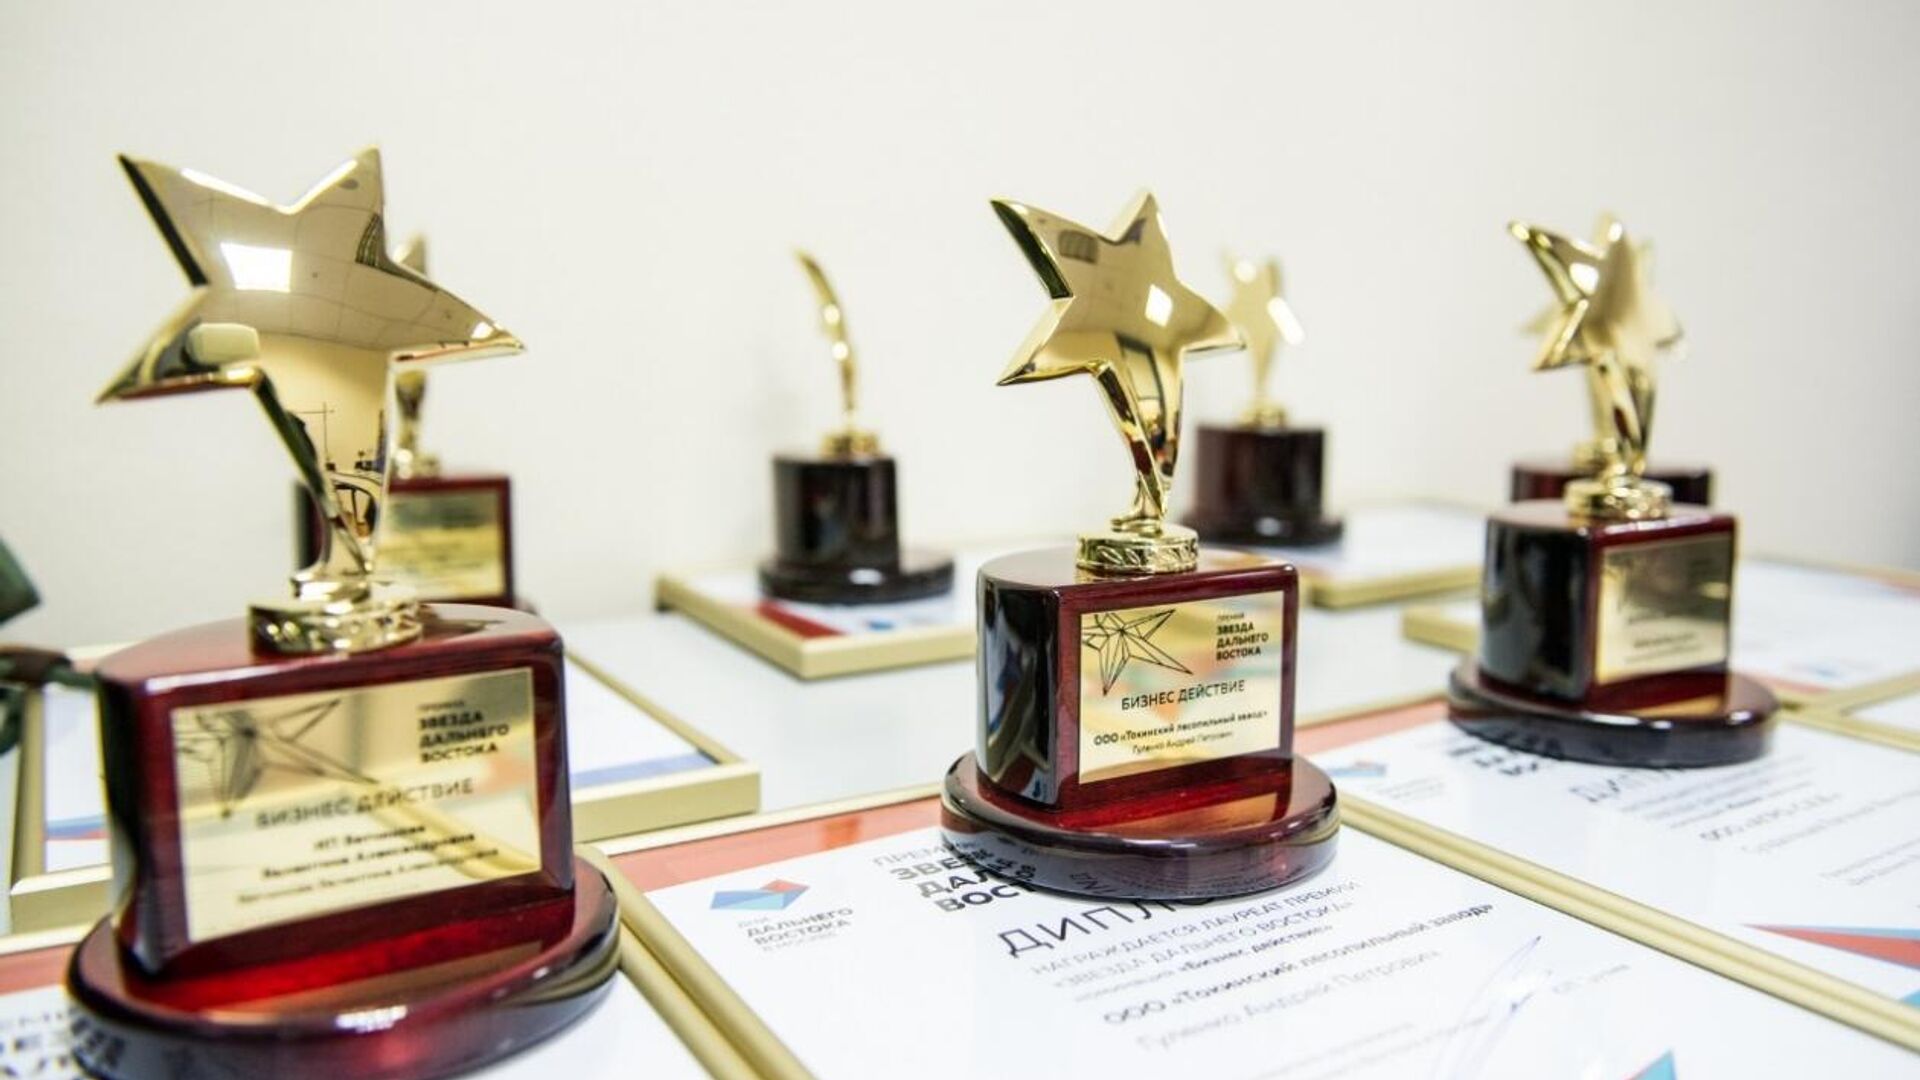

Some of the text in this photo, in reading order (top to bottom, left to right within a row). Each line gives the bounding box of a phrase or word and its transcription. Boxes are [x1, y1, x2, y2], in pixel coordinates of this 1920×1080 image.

[1216, 621, 1254, 635] ЗВЕЗДА
[1216, 632, 1269, 649] ДАЛЬНЕГО
[1216, 646, 1261, 661] ВОСТОКА
[1121, 680, 1245, 711] БИЗНЕС ДЕЙСТВИЕ
[417, 710, 484, 731] ЗВЕЗДА
[1094, 732, 1119, 746] ООО
[1176, 712, 1235, 732] лесопильный
[418, 724, 510, 749] ДАЛЬНЕГО
[420, 742, 499, 764] ВОСТОКА
[256, 778, 474, 829] БИЗНЕС ДЕЙСТВИЕ
[747, 908, 853, 938] ДАЛЬНЕГО
[1201, 901, 1283, 931] ЛАУРЕАТ
[754, 919, 851, 945] ВОСТОКА
[1150, 926, 1257, 964] ДАЛЬНЕГО
[1104, 999, 1166, 1024] ООО
[1300, 921, 1429, 968] лесопильный
